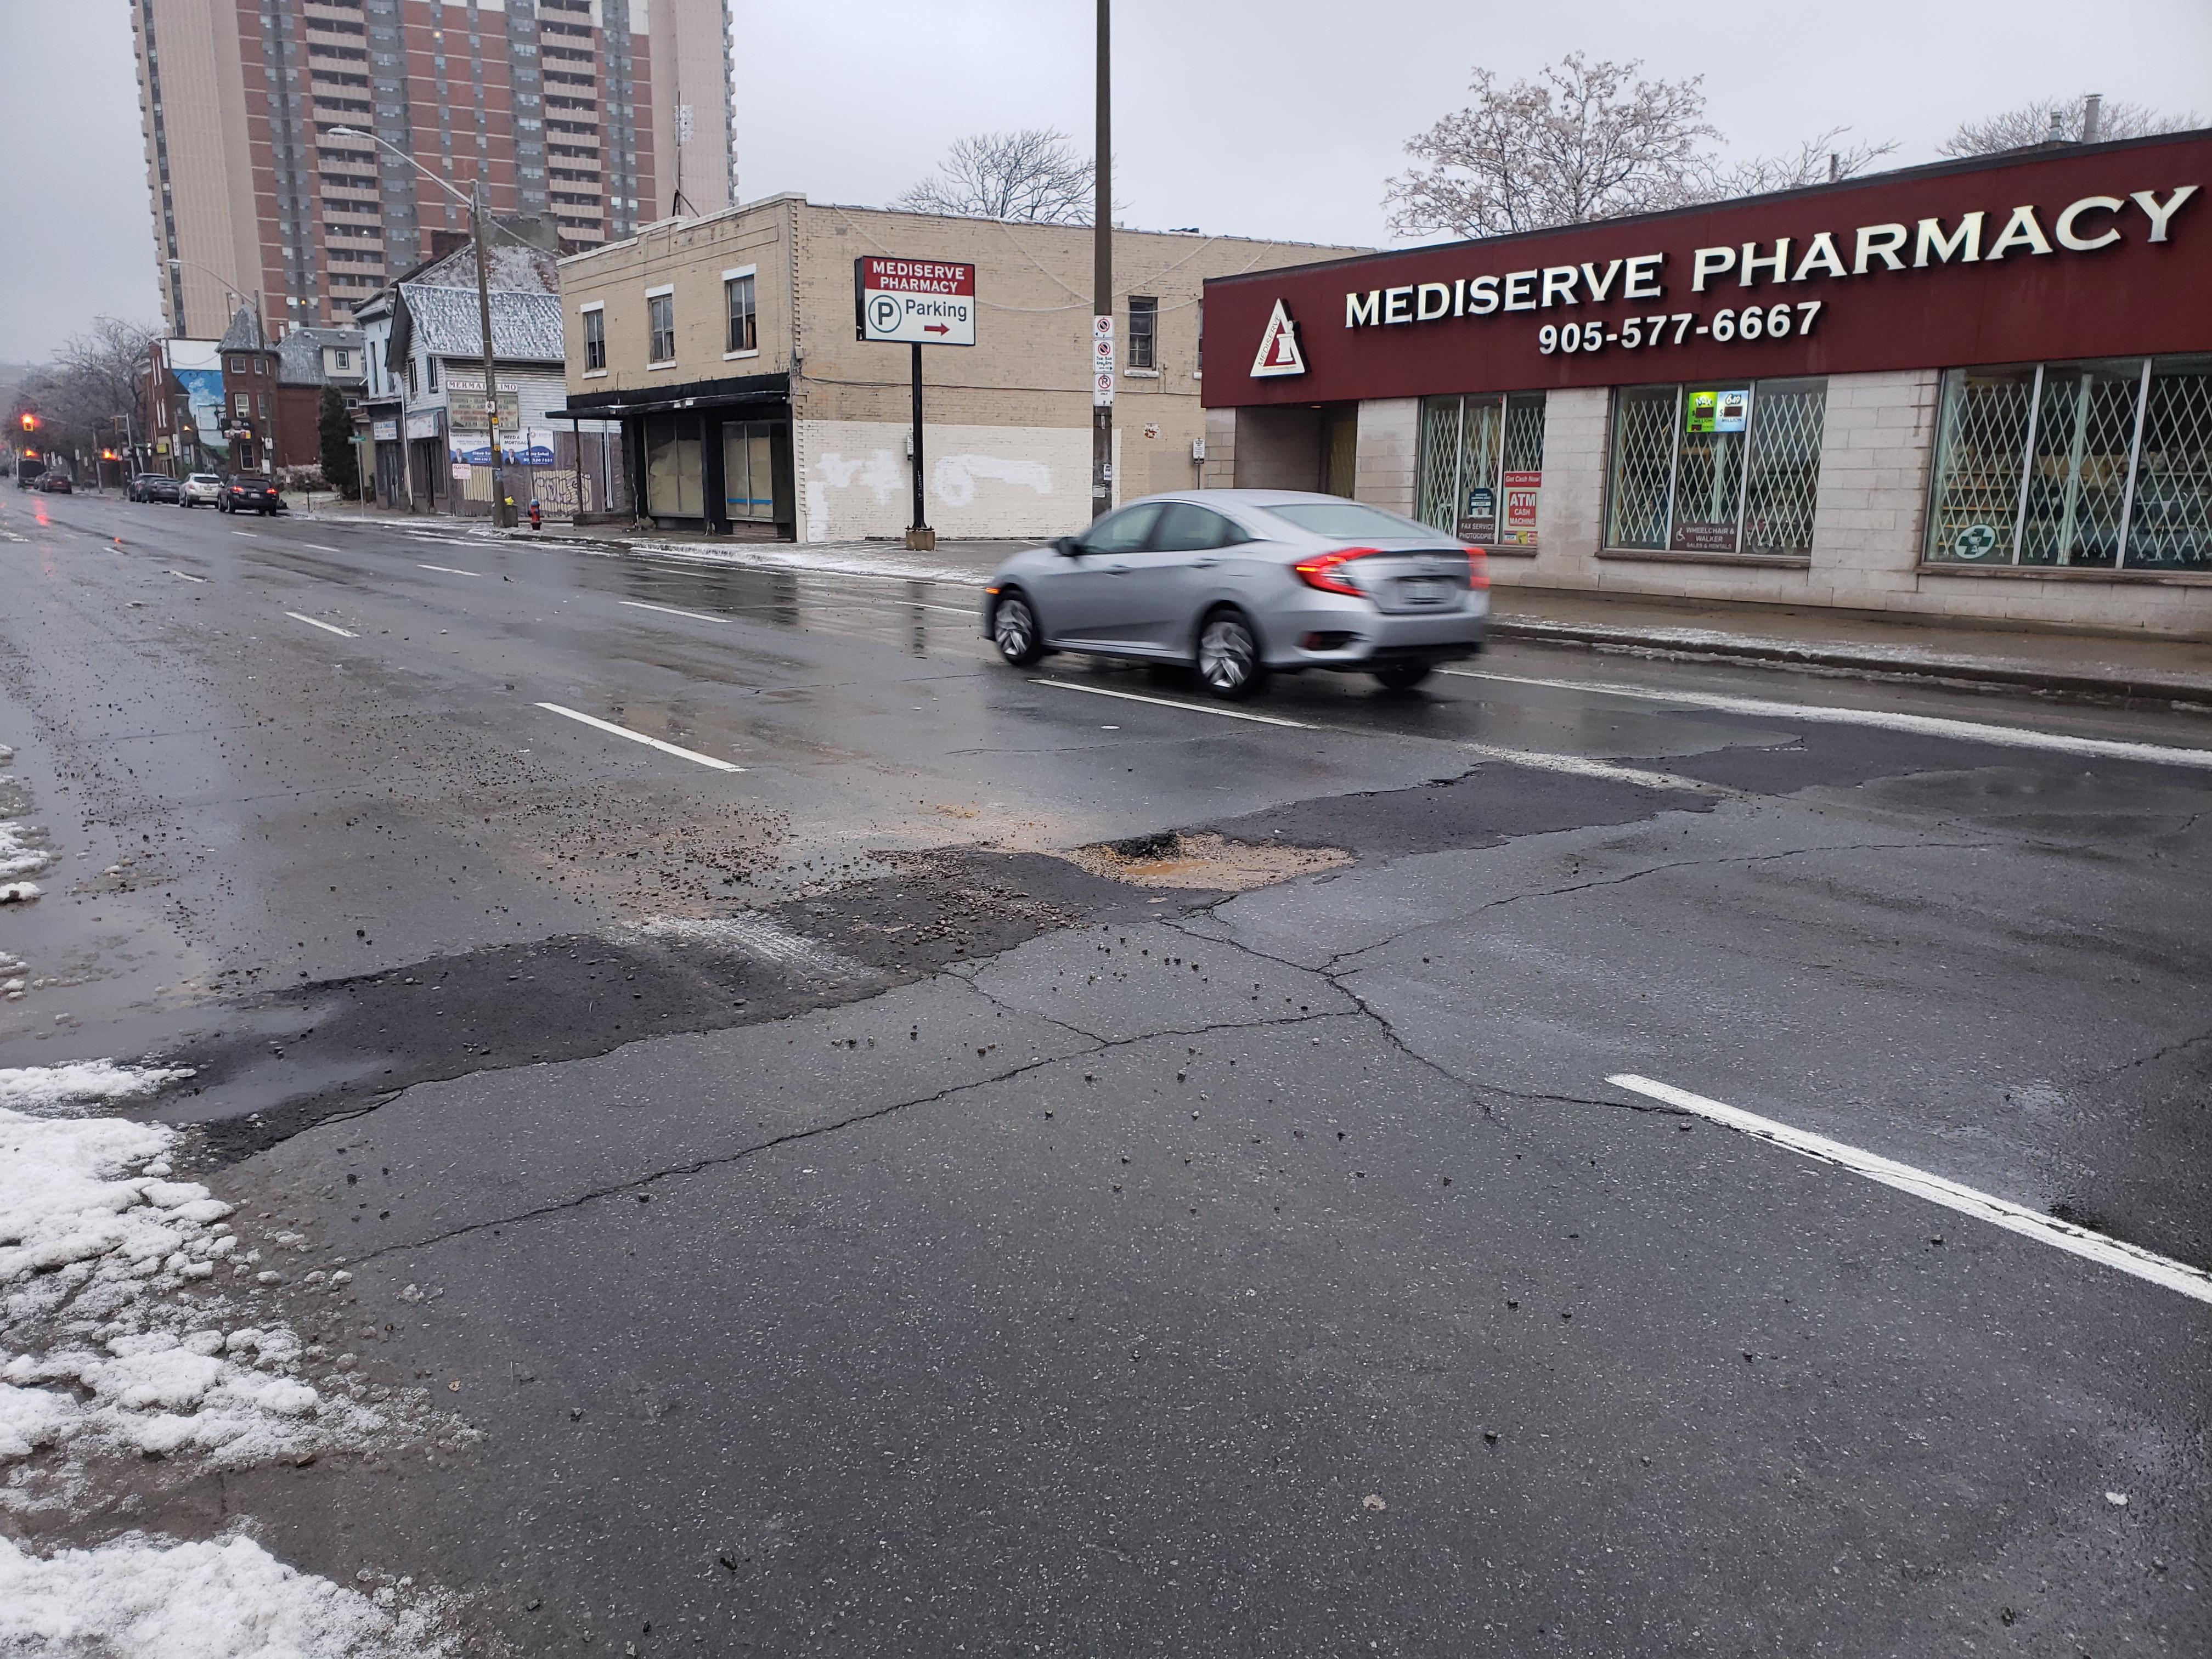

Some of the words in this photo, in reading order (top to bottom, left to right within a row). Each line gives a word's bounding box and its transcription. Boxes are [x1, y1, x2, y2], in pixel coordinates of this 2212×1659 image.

[1345, 252, 1663, 329] MEDISERVE
[1691, 185, 2200, 292] PHARMACY
[873, 261, 965, 280] MEDISERVE
[879, 276, 958, 293] PHARMACY
[878, 301, 894, 325] P
[905, 299, 967, 321] Parking
[1538, 301, 1821, 355] 905-577-6667
[1258, 313, 1281, 367] MEDISERVE
[450, 381, 486, 390] MERMAI
[1510, 494, 1536, 506] ATM
